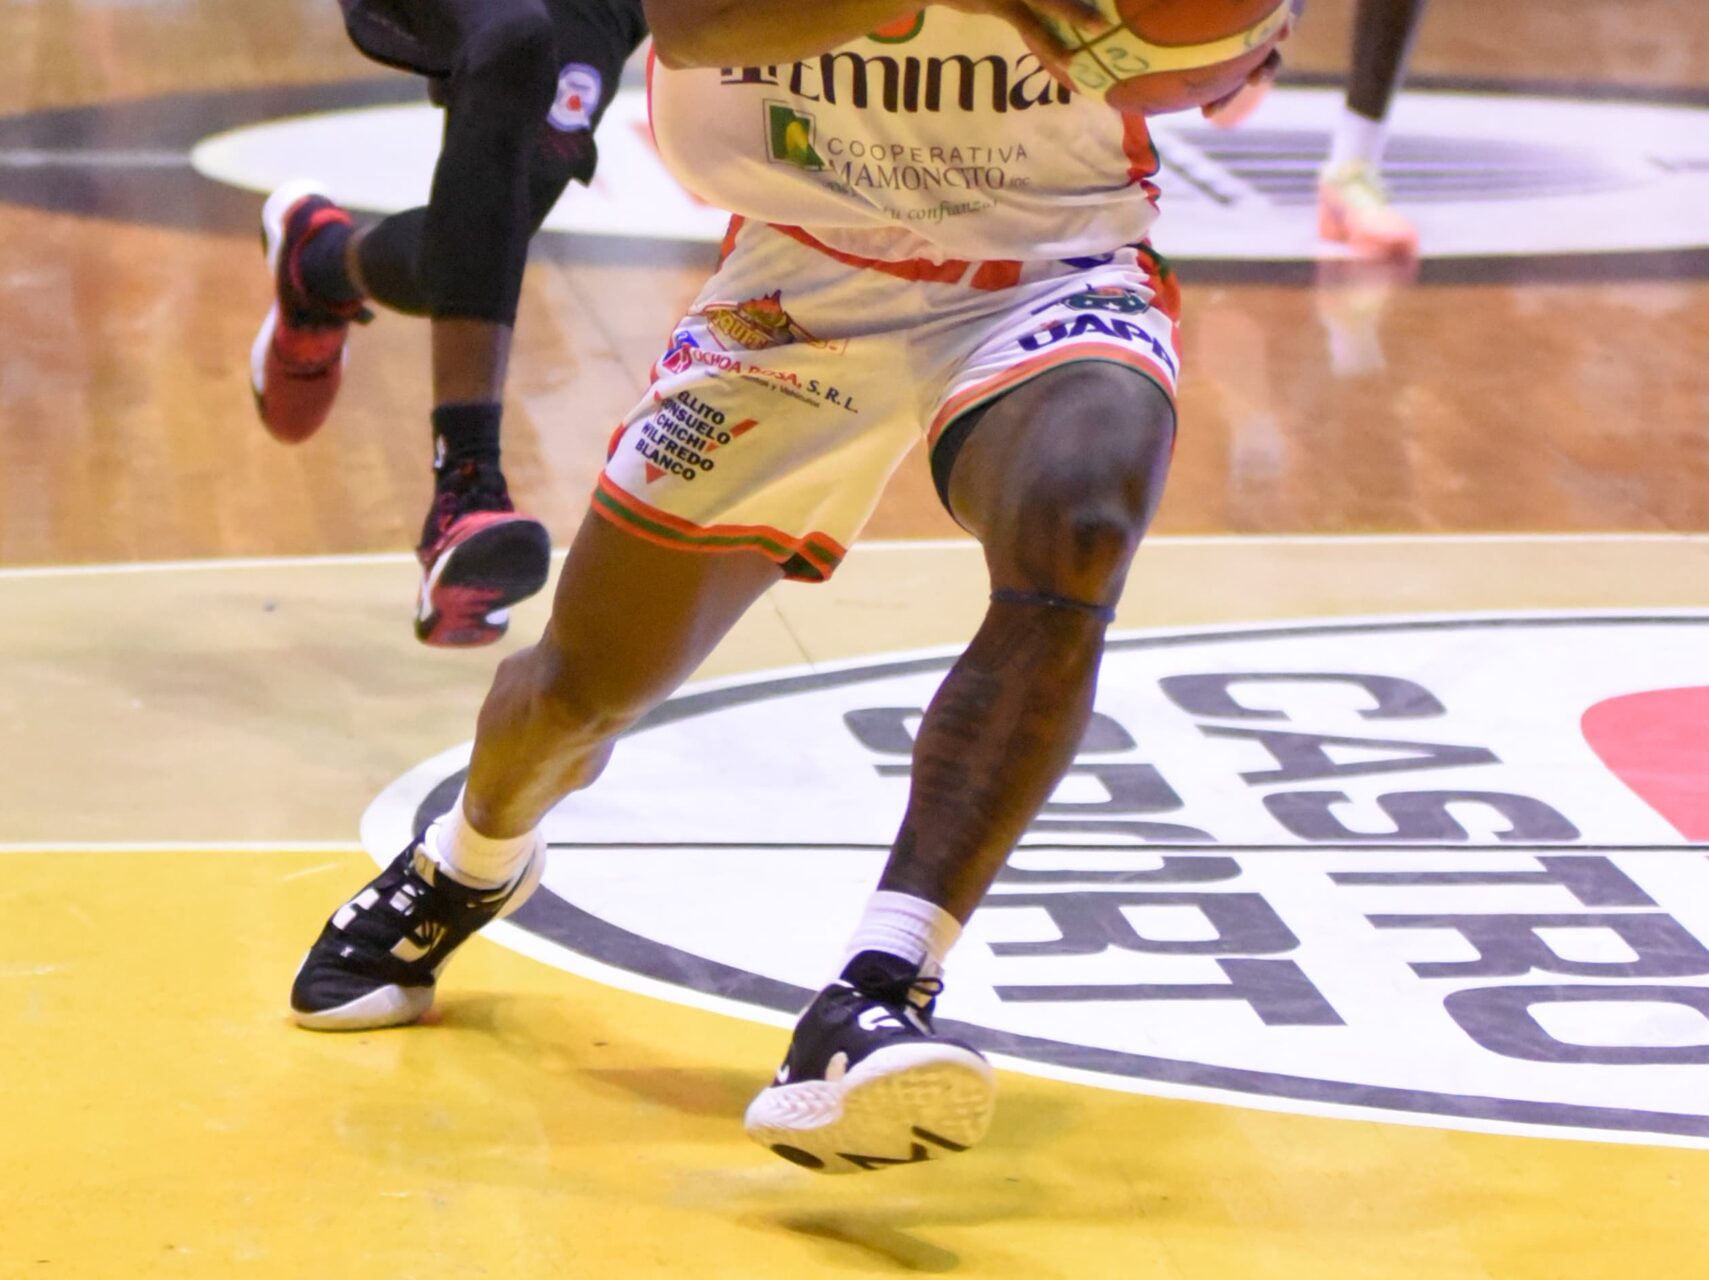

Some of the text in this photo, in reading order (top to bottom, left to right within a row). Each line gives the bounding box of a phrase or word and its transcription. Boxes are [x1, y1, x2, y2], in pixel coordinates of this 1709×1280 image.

[826, 136, 1029, 165] COOPERATIVA
[640, 422, 715, 472] WILFREDO
[655, 414, 706, 451] CHICHI
[634, 438, 697, 482] BLANCO
[1158, 673, 1709, 1065] CASTRO
